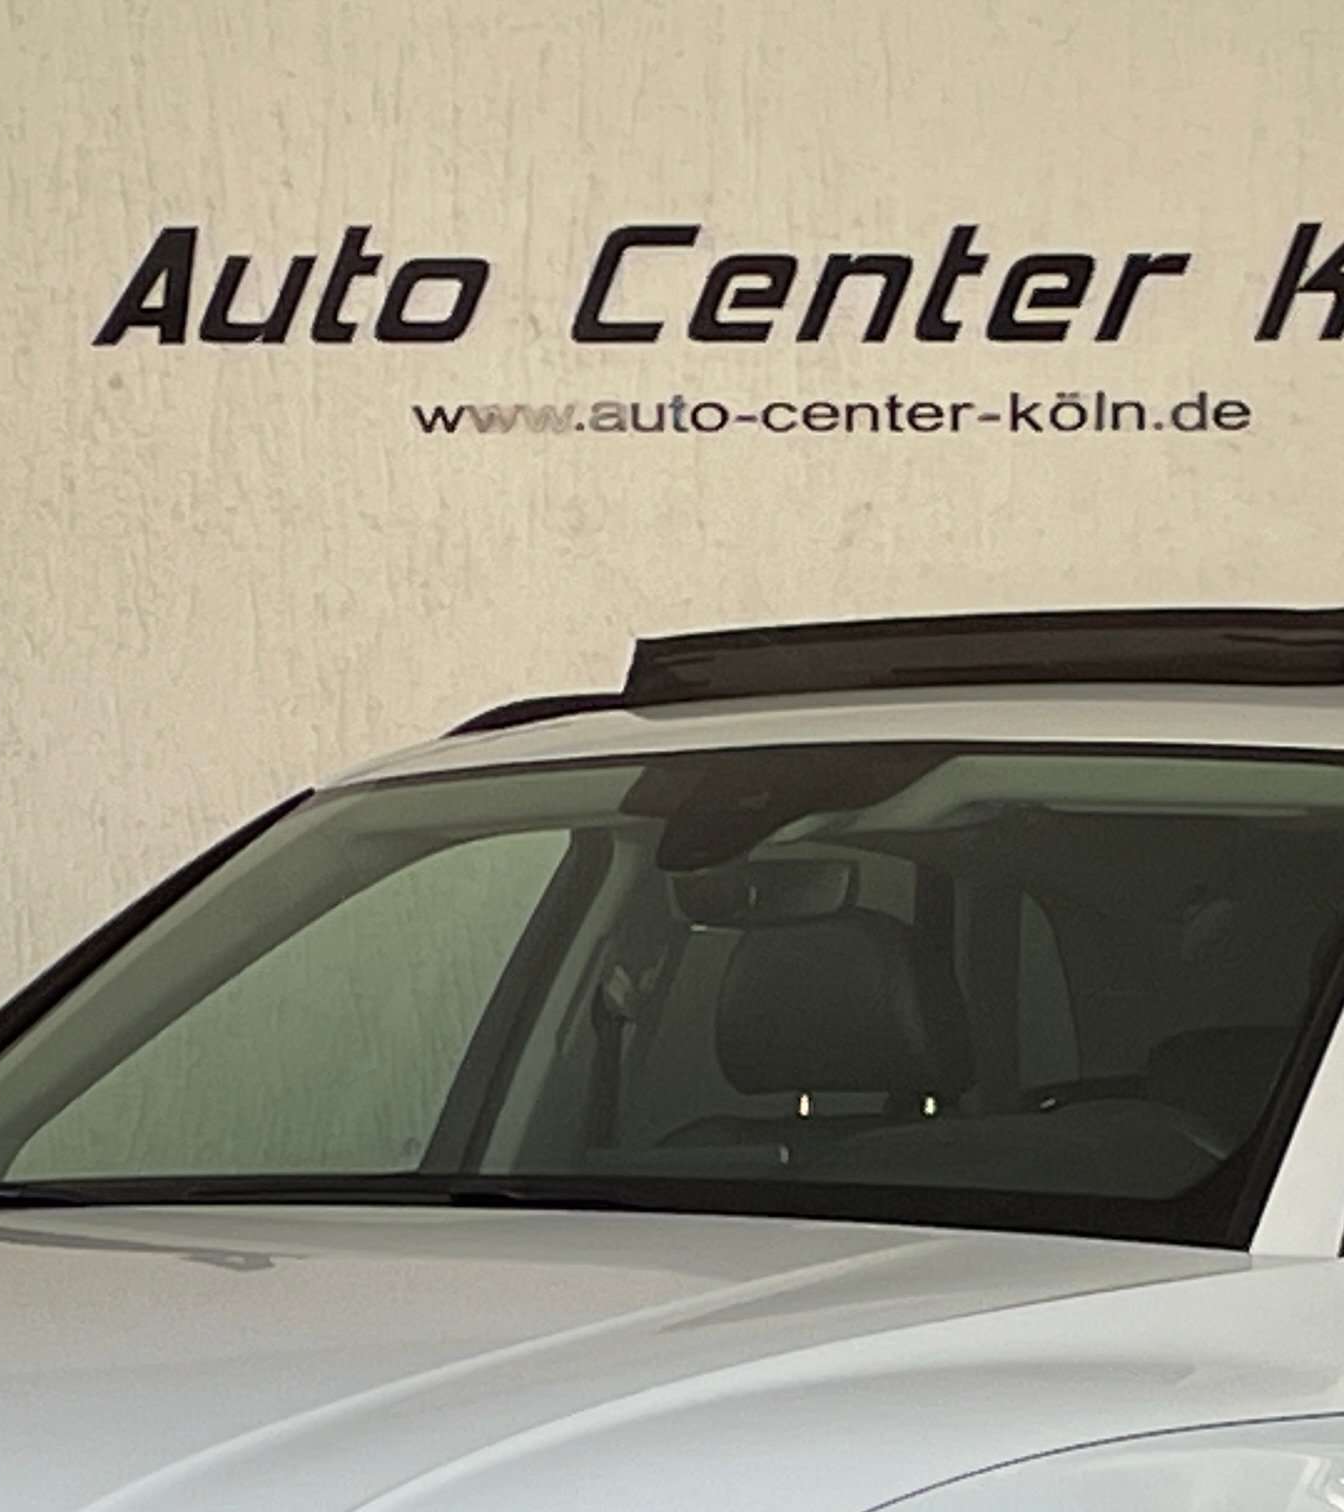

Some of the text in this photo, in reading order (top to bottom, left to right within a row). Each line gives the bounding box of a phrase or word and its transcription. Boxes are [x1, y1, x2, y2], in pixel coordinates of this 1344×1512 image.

[92, 226, 490, 346] Auto
[571, 225, 1192, 344] Center
[411, 390, 1252, 434] www.auto-center-köln.de
